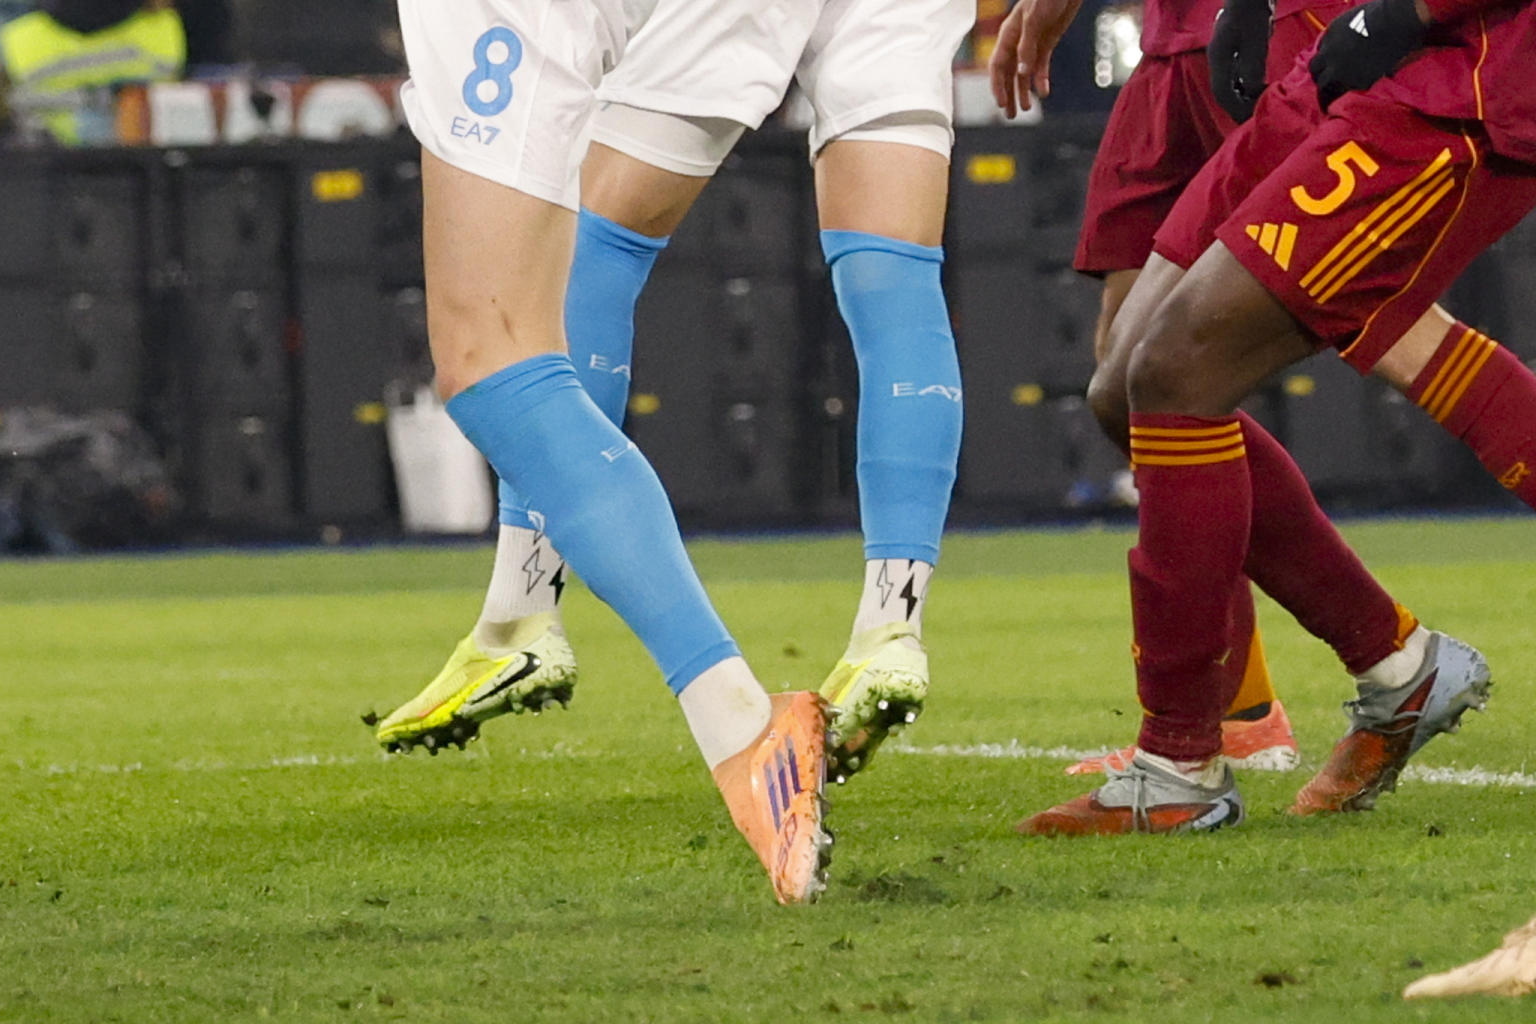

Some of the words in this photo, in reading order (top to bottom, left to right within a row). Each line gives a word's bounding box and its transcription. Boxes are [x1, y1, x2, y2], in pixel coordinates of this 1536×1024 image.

[462, 26, 523, 117] 8
[450, 116, 502, 146] EA7
[1290, 140, 1380, 216] 5
